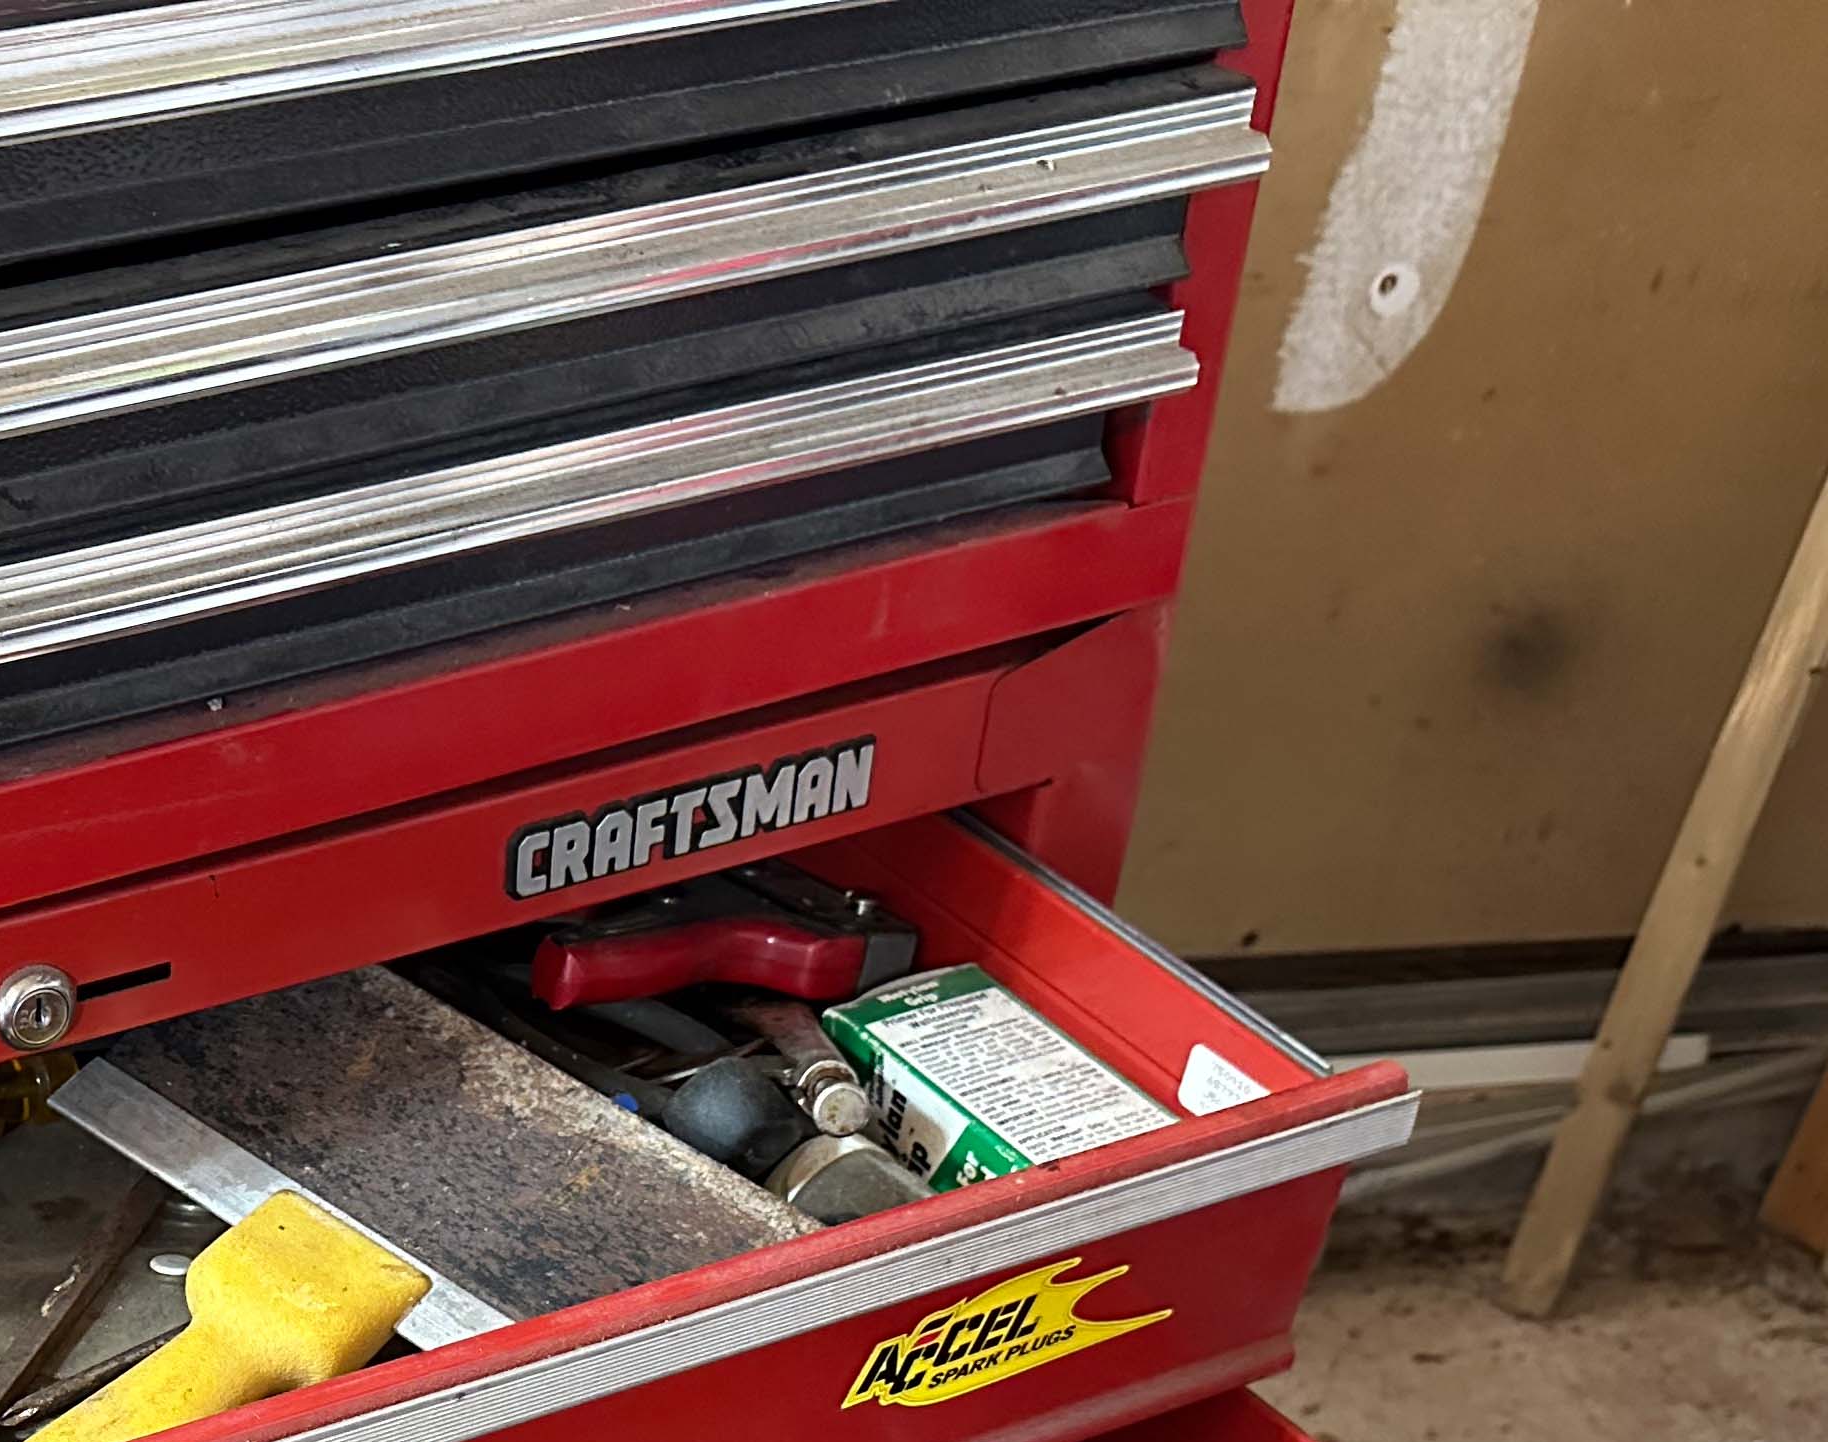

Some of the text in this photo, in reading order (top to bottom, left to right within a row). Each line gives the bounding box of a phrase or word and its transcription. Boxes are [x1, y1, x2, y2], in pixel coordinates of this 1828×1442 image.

[514, 741, 876, 899] CRAFTSMAN
[855, 1293, 1040, 1397] ACCEL
[927, 1325, 1077, 1389] SPARK PLUGS
